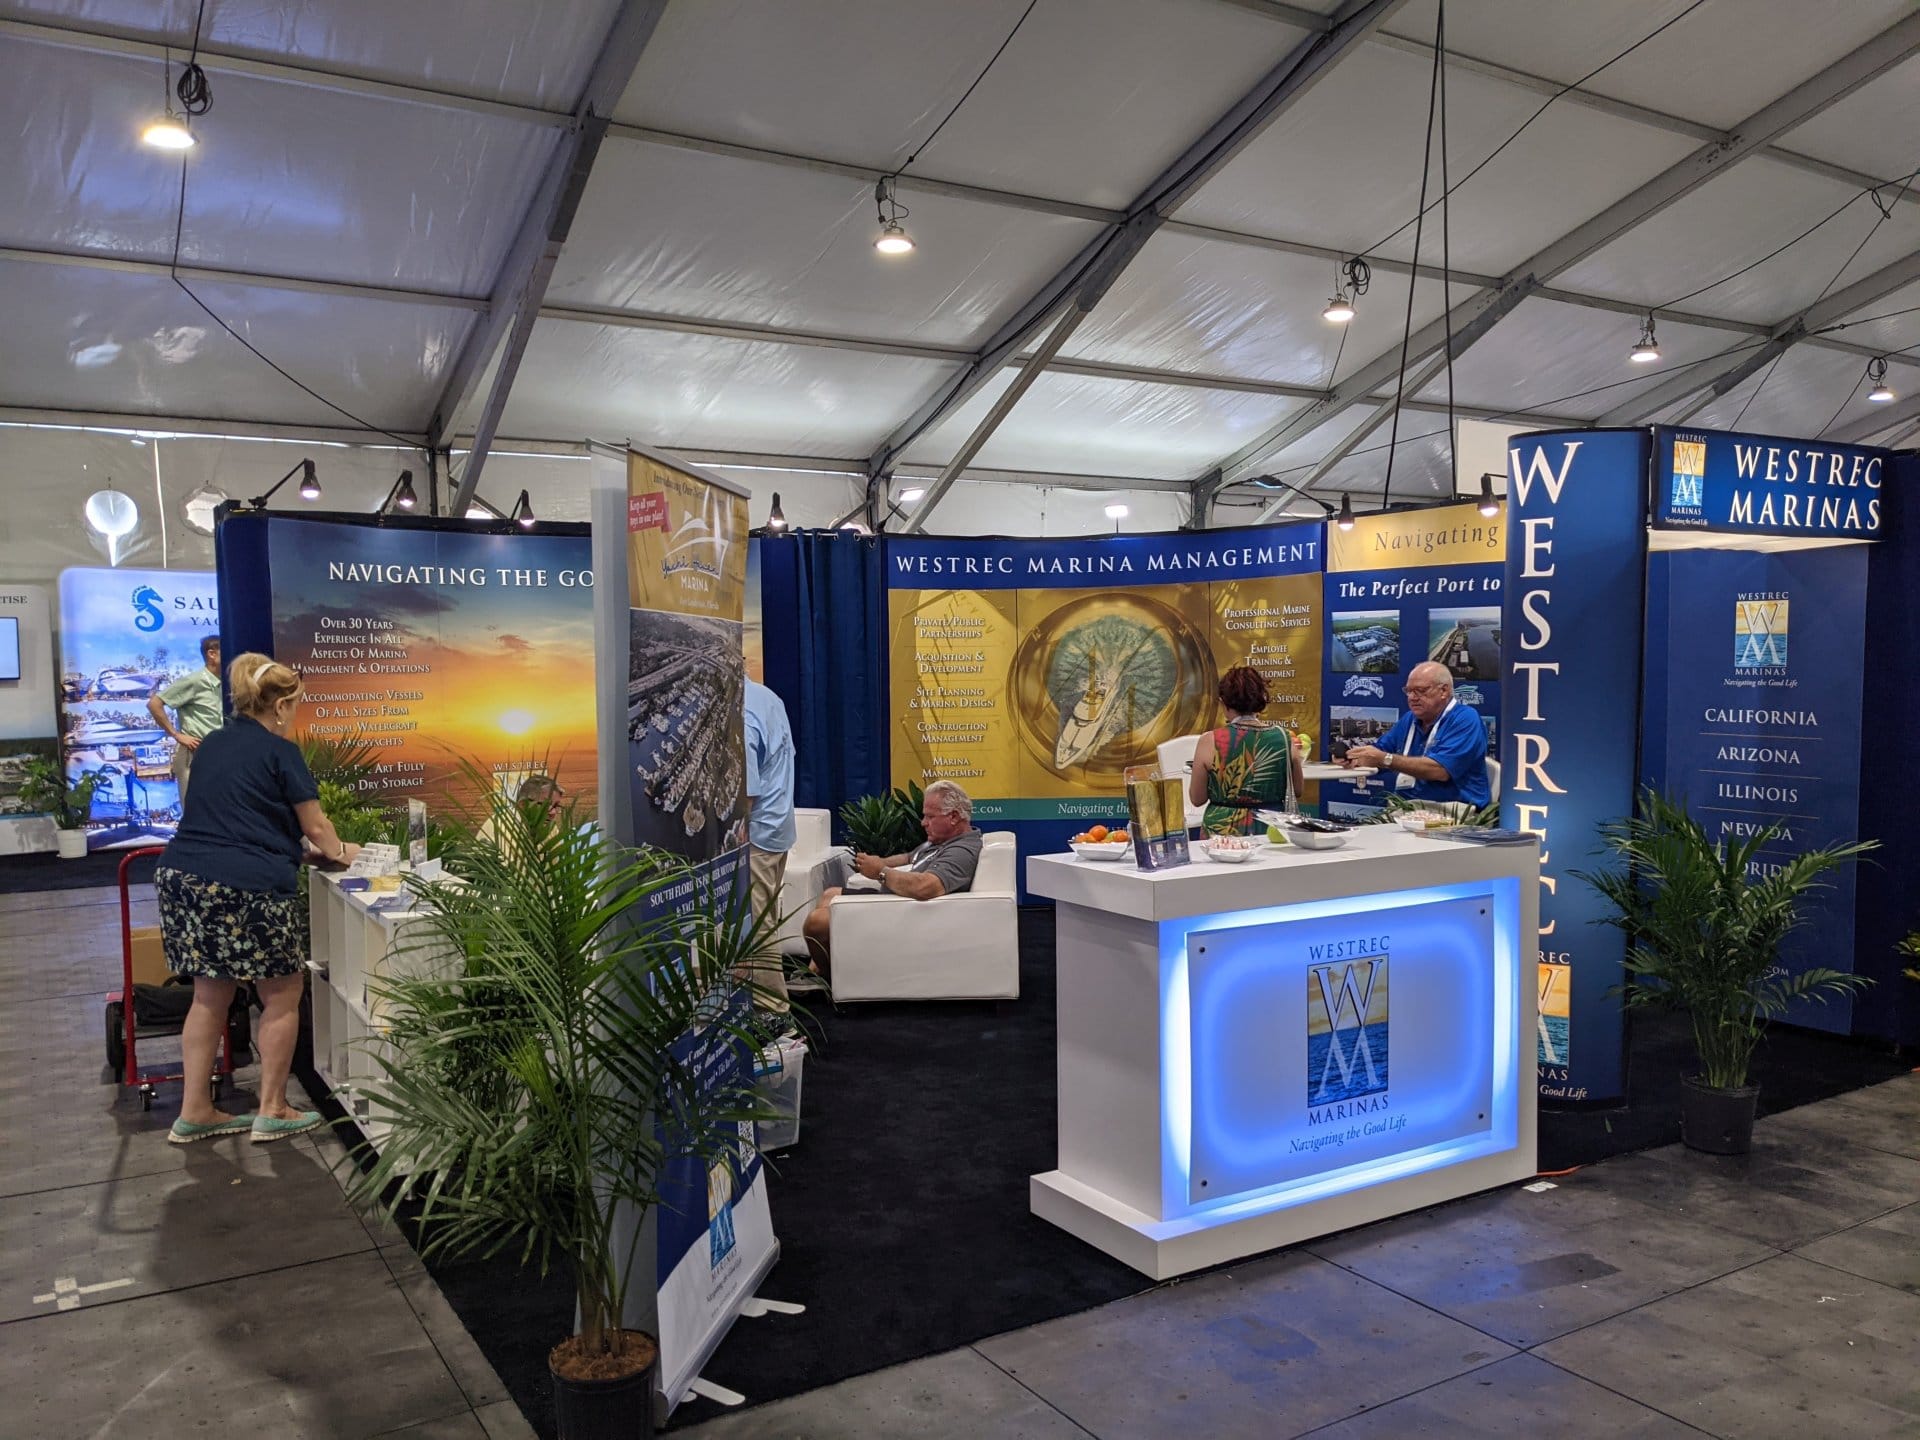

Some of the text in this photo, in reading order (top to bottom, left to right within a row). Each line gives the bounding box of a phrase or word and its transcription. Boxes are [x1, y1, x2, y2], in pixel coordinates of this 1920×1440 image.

[1675, 433, 1707, 443] WESTREC
[1734, 444, 1882, 489] WESTREC
[1671, 507, 1702, 516] MARINAS
[1728, 489, 1880, 530] MARINAS
[1375, 522, 1500, 553] Navigating
[896, 542, 1318, 574] WESTREC MARINA MANAGEMENT
[328, 561, 487, 586] NAVIGATING
[497, 568, 548, 588] THE
[681, 575, 709, 592] MARINA
[1339, 576, 1501, 600] The Perfect Port to
[1737, 591, 1789, 600] WESTREC
[1224, 604, 1311, 618] PROFESSIONAL MARINE
[320, 617, 394, 630] OVER 30 YEARS
[914, 616, 985, 626] PRIVATE/PUBLIC
[1225, 617, 1311, 631] CONSULTING SERVICES
[314, 632, 402, 644] EXPERIENCE IN ALL
[920, 628, 982, 638] PARTNERSHIPS
[311, 647, 408, 659] ASPECTS OF MARINA
[1251, 643, 1288, 654] EMPLOYEE
[915, 651, 985, 663] ACQUISITION &
[1244, 655, 1292, 667] TRAINING &
[358, 663, 368, 674] &
[370, 662, 431, 674] OPERATIONS
[920, 663, 983, 673] DEVELOPMENT
[1734, 668, 1786, 676] MARINAS
[1723, 678, 1757, 688] Navigating
[1757, 678, 1767, 686] the
[1785, 679, 1798, 688] Life
[301, 690, 424, 703] ACCOMMODATING VESSELS
[916, 686, 984, 697] SITE PLANNING
[1276, 693, 1306, 703] SERVICE
[909, 698, 994, 708] & MARINA DESIGN
[316, 704, 409, 718] OF ALL SIZES FROM
[1704, 708, 1818, 726] CALIFORNIA
[310, 722, 353, 734] PERSONAL
[917, 721, 988, 732] CONSTRUCTION
[1291, 717, 1299, 728] &
[921, 734, 984, 743] MANAGEMENT
[932, 756, 970, 766] MARINA
[1717, 746, 1801, 764] ARIZONA
[374, 763, 394, 774] ART
[397, 761, 425, 772] FULLY
[921, 768, 985, 778] MANAGEMENT
[358, 779, 380, 791] DRY
[382, 777, 425, 789] STORAGE
[1718, 783, 1799, 803] ILLINOIS
[1058, 803, 1114, 817] Navigating
[1721, 820, 1793, 841] NEVADA
[650, 889, 674, 907] SOUTH
[1309, 936, 1390, 960] WESTREC
[1538, 951, 1571, 965] REC
[1539, 1084, 1588, 1100] Good Life
[1308, 1094, 1389, 1127] MARINAS
[1288, 1113, 1408, 1154] Navigating the Good Life
